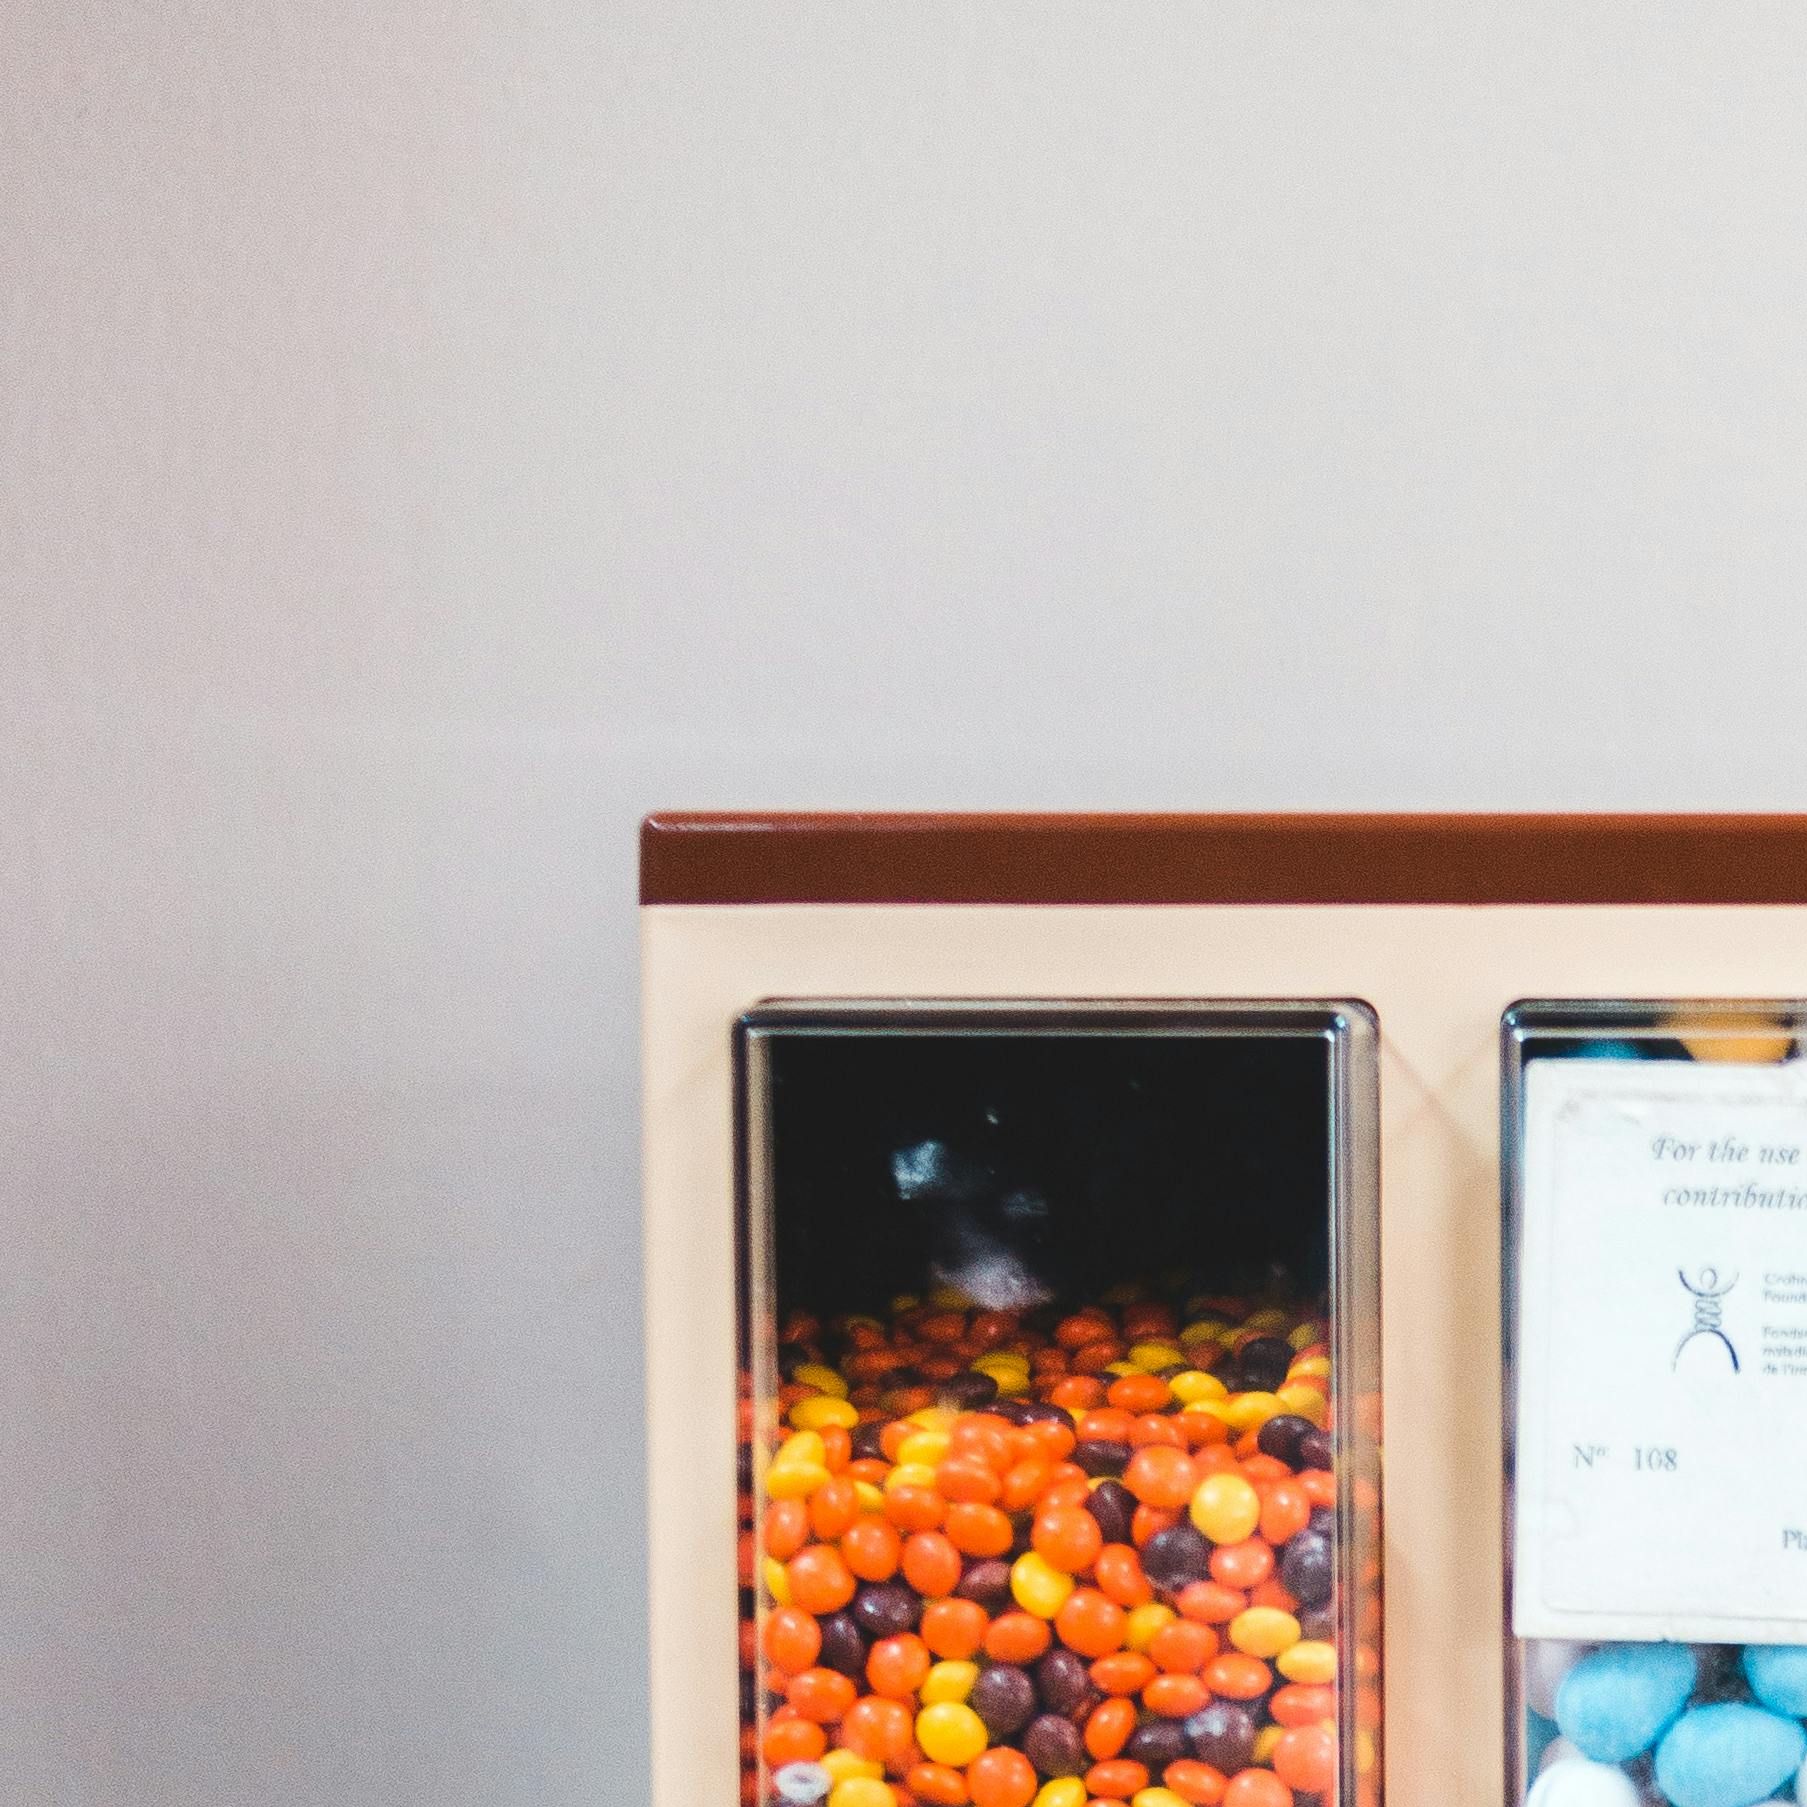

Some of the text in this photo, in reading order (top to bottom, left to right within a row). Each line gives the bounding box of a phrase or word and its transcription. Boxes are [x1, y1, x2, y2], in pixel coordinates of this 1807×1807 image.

[1652, 1135, 1699, 1162] For
[1707, 1137, 1749, 1163] the
[1759, 1145, 1800, 1165] use
[1635, 1447, 1677, 1472] 108
